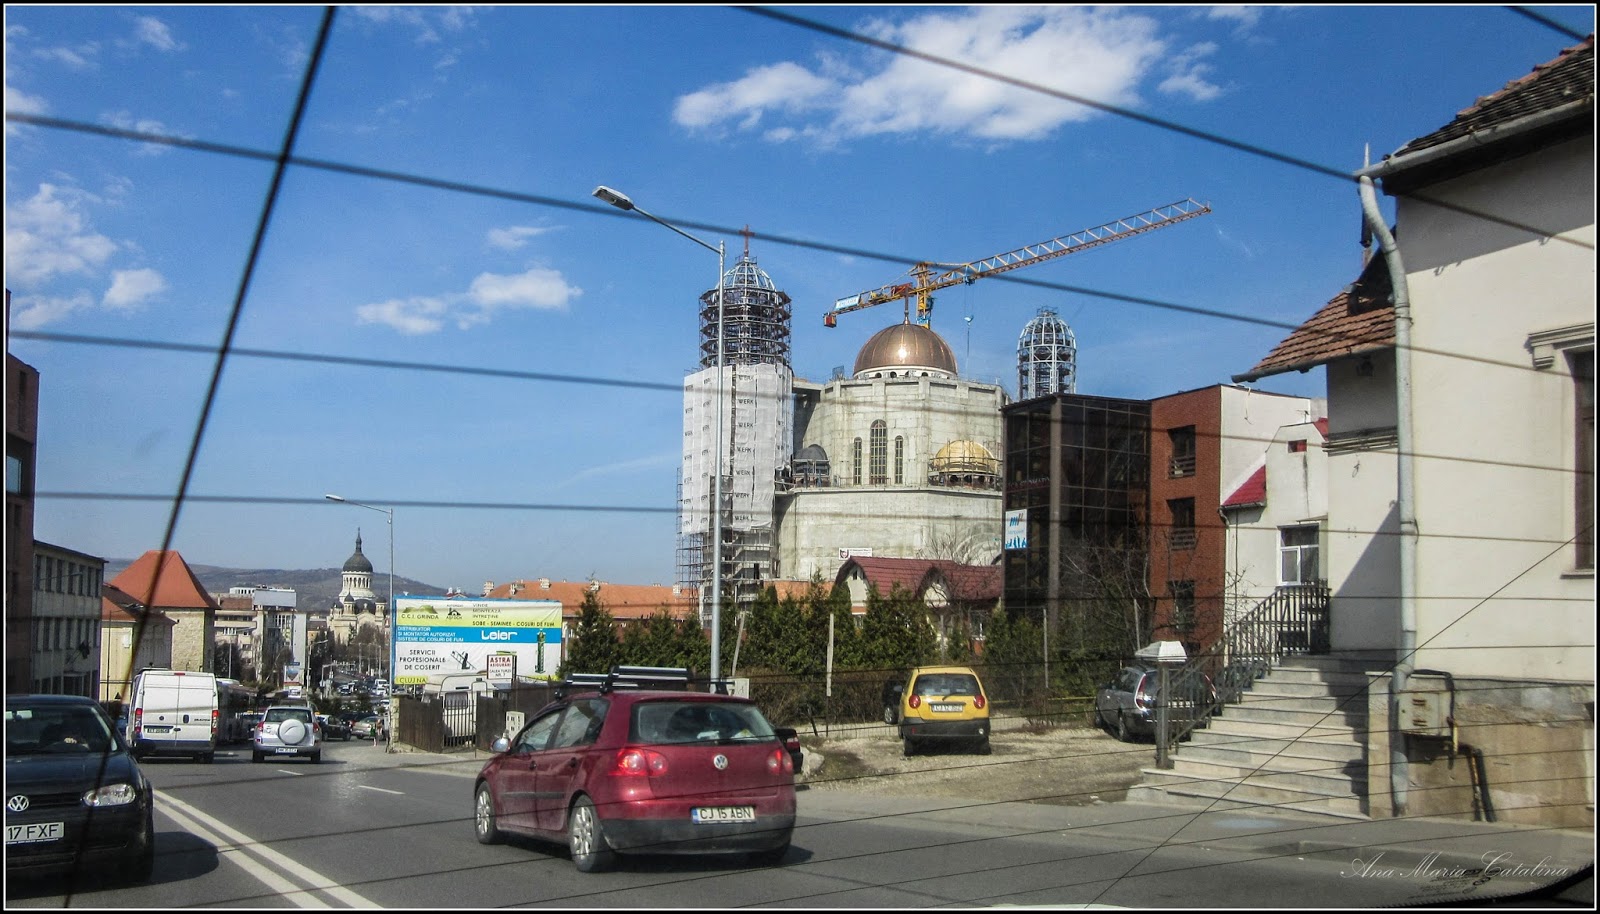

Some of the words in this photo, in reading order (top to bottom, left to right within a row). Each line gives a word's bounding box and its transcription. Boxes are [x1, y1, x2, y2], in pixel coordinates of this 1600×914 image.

[481, 630, 518, 640] Leier
[700, 808, 714, 819] CJ
[717, 808, 727, 819] 15
[730, 807, 751, 819] ABN
[7, 827, 22, 840] 17
[26, 823, 59, 839] FXF
